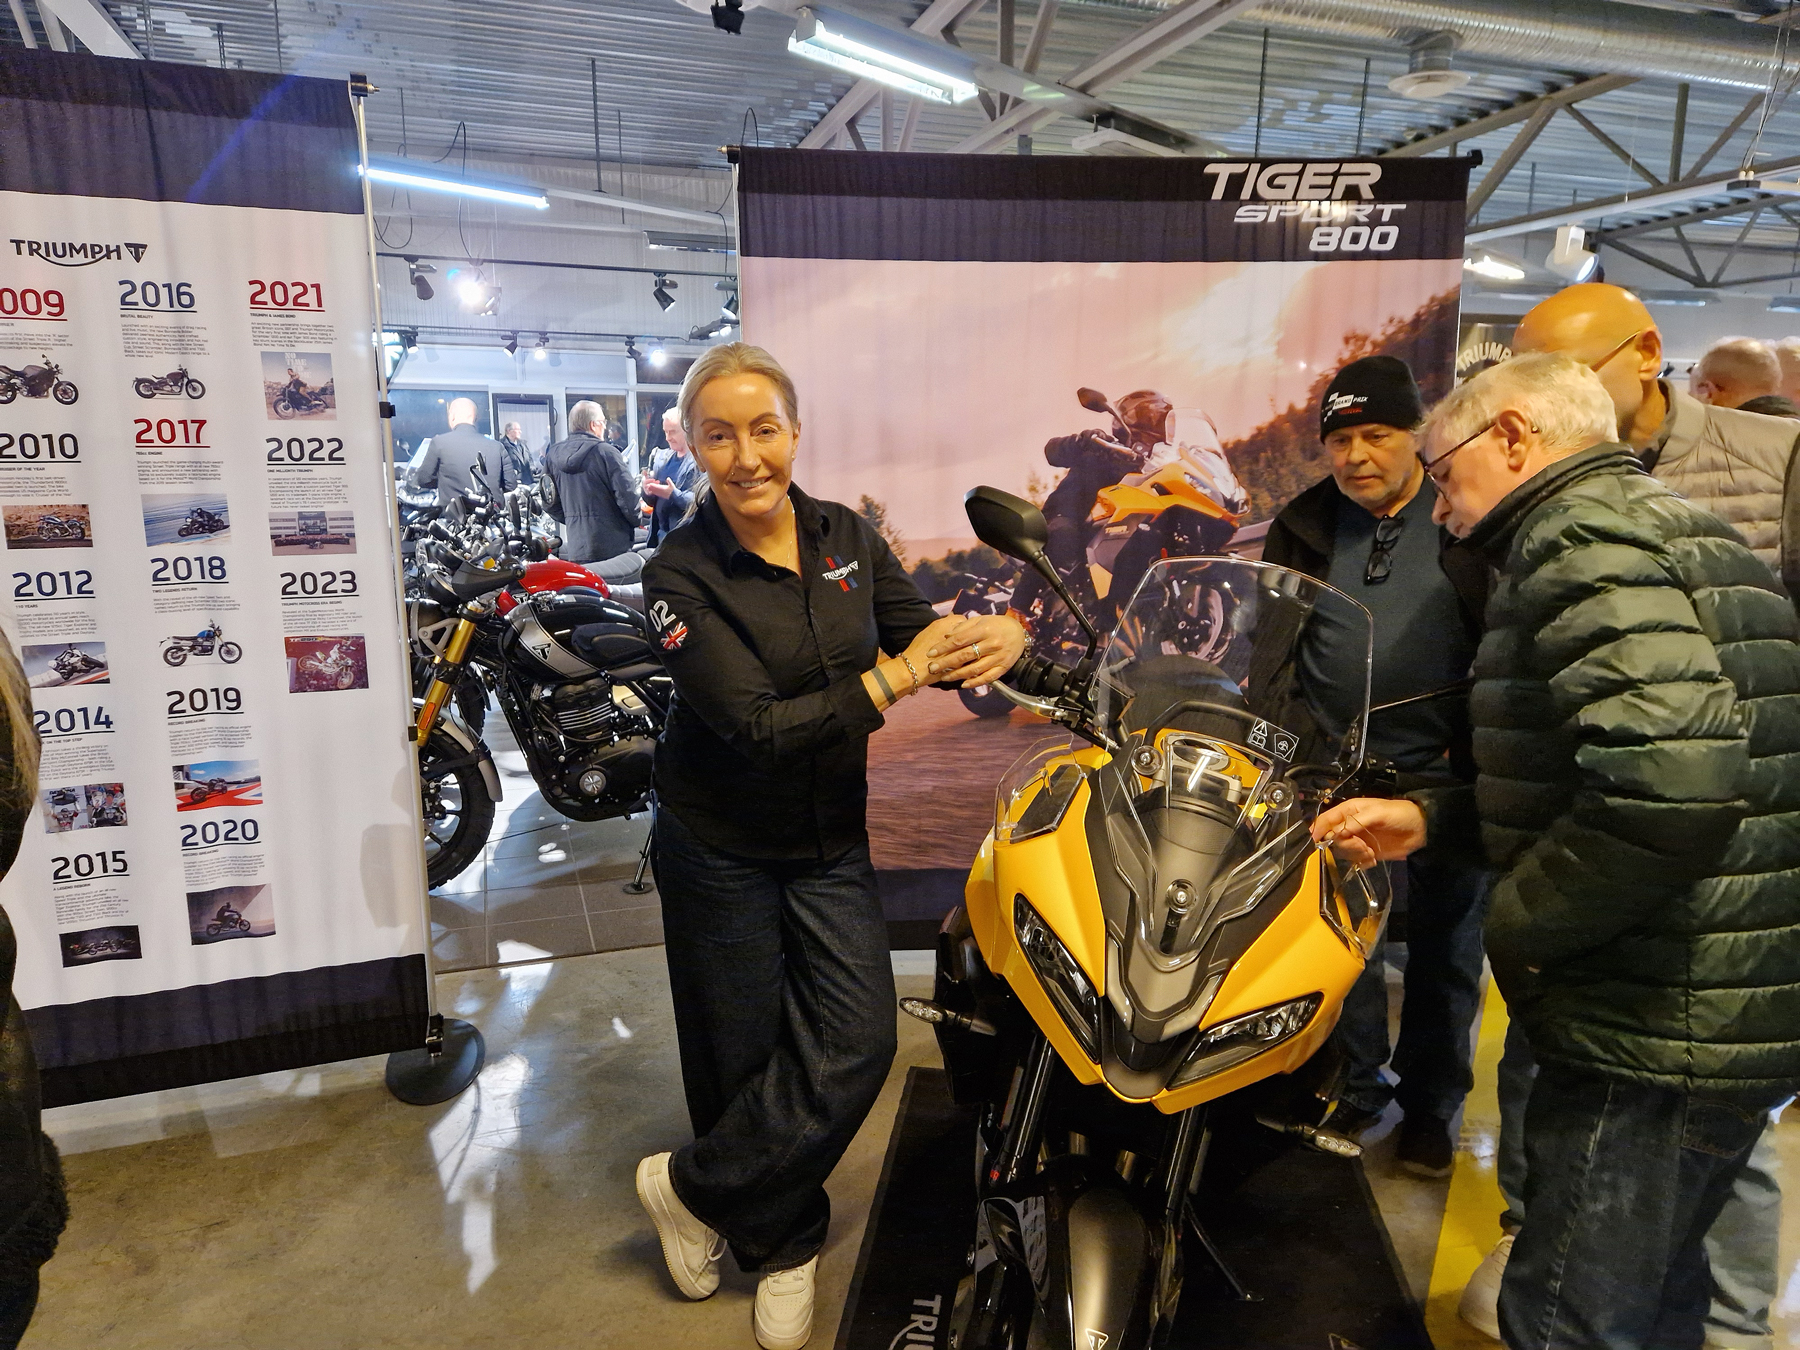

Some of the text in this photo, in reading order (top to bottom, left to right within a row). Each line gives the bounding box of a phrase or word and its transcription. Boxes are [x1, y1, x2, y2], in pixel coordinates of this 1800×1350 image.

[1203, 162, 1382, 200] TIGER
[1233, 203, 1407, 222] SPORT
[1309, 225, 1400, 251] 800
[10, 238, 122, 267] TRIUMPH
[0, 287, 65, 317] 009
[118, 279, 196, 309] 2016
[248, 279, 323, 308] 2021
[1457, 341, 1512, 371] TRIUMP
[133, 418, 208, 444] 2017
[0, 432, 79, 459] 2010
[265, 437, 345, 462] 2022
[150, 555, 227, 582] 2018
[822, 566, 852, 580] TRIUMPH
[12, 570, 94, 597] 2012
[280, 570, 358, 596] 2023
[649, 600, 677, 633] 02
[166, 687, 242, 715] 2019
[33, 706, 114, 734] 2014
[180, 818, 259, 847] 2020
[51, 850, 128, 880] 2015
[891, 1294, 942, 1350] TRI
